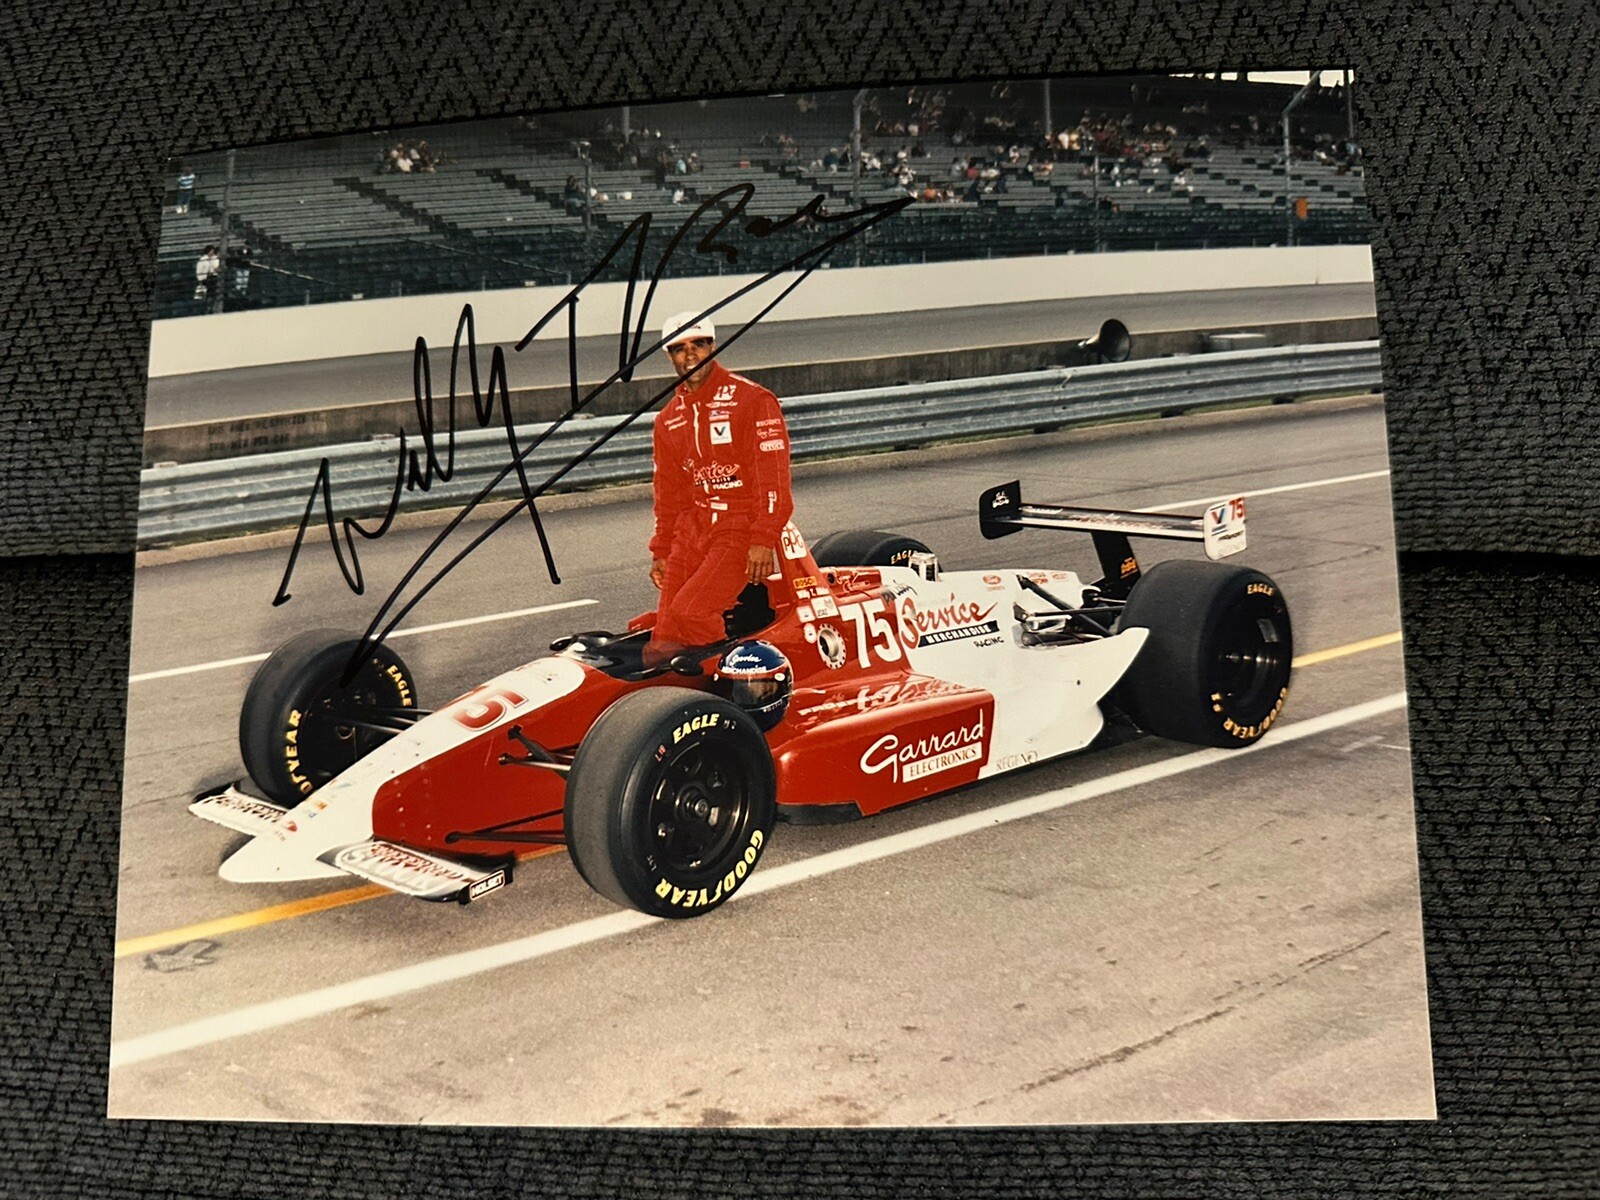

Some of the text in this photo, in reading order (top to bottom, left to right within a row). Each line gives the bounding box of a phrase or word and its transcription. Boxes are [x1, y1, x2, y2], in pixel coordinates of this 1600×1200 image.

[1229, 496, 1246, 521] 75
[890, 549, 914, 565] EAGL
[793, 577, 818, 588] BOSC
[1246, 583, 1275, 597] EAGLE
[838, 598, 903, 670] 75
[901, 592, 998, 651] Service
[924, 623, 992, 646] MERCHANDISE
[973, 636, 1005, 649] RACING
[386, 664, 413, 707] EAGLE
[672, 712, 720, 745] EAGLE
[860, 708, 986, 783] Garrard
[909, 747, 978, 778] ELECTRONICS
[655, 830, 765, 908] GOODYEAR
